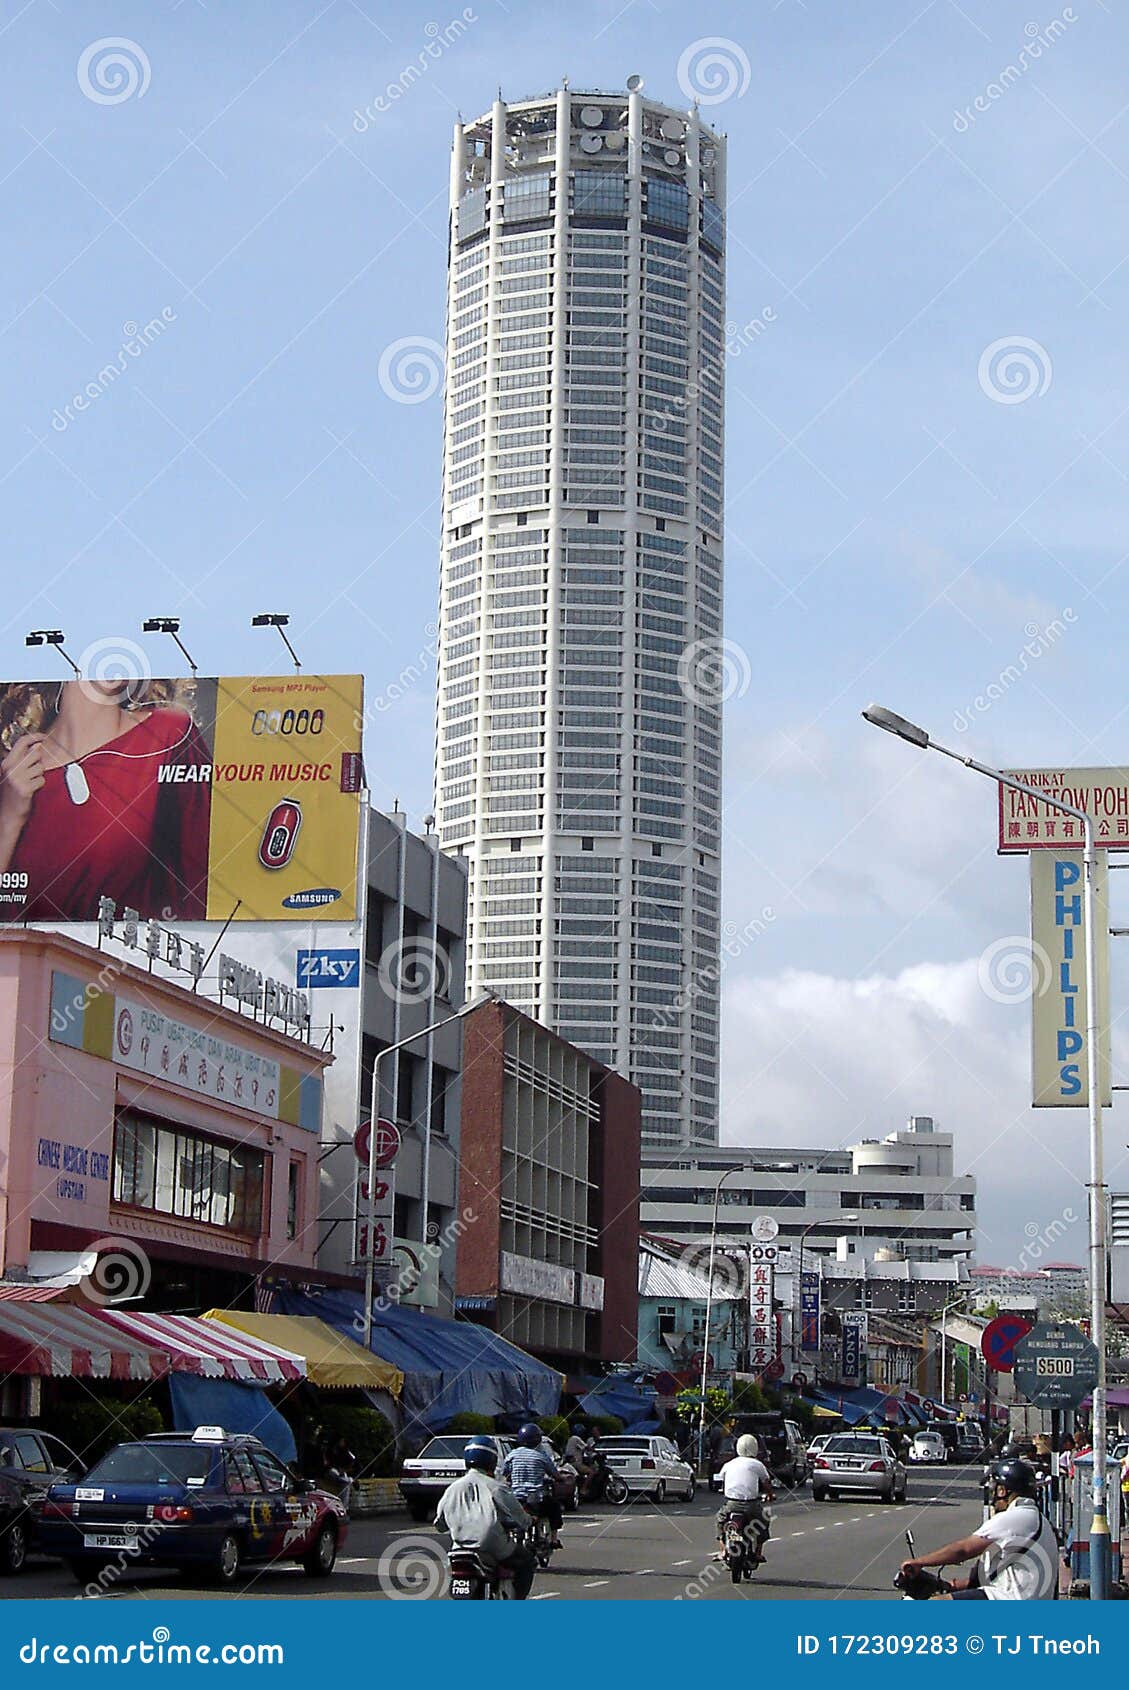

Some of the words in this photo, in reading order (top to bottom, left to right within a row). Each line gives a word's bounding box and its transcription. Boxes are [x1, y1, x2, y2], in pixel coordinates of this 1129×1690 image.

[157, 764, 212, 783] WEAR
[214, 764, 265, 782] YOUR
[269, 763, 332, 782] MUSIC
[1009, 773, 1065, 787] YARIKAT
[1008, 788, 1039, 818] TAN
[1094, 786, 1129, 816] POH
[289, 894, 334, 903] SAMSUNG
[300, 955, 356, 981] Zky
[1055, 861, 1082, 1095] PHILIPS
[38, 1138, 61, 1170] CHINESE
[63, 1144, 88, 1176] MEDICINE
[91, 1151, 109, 1181] CENTRE
[846, 1328, 856, 1375] SONY
[1038, 1359, 1072, 1374] $500
